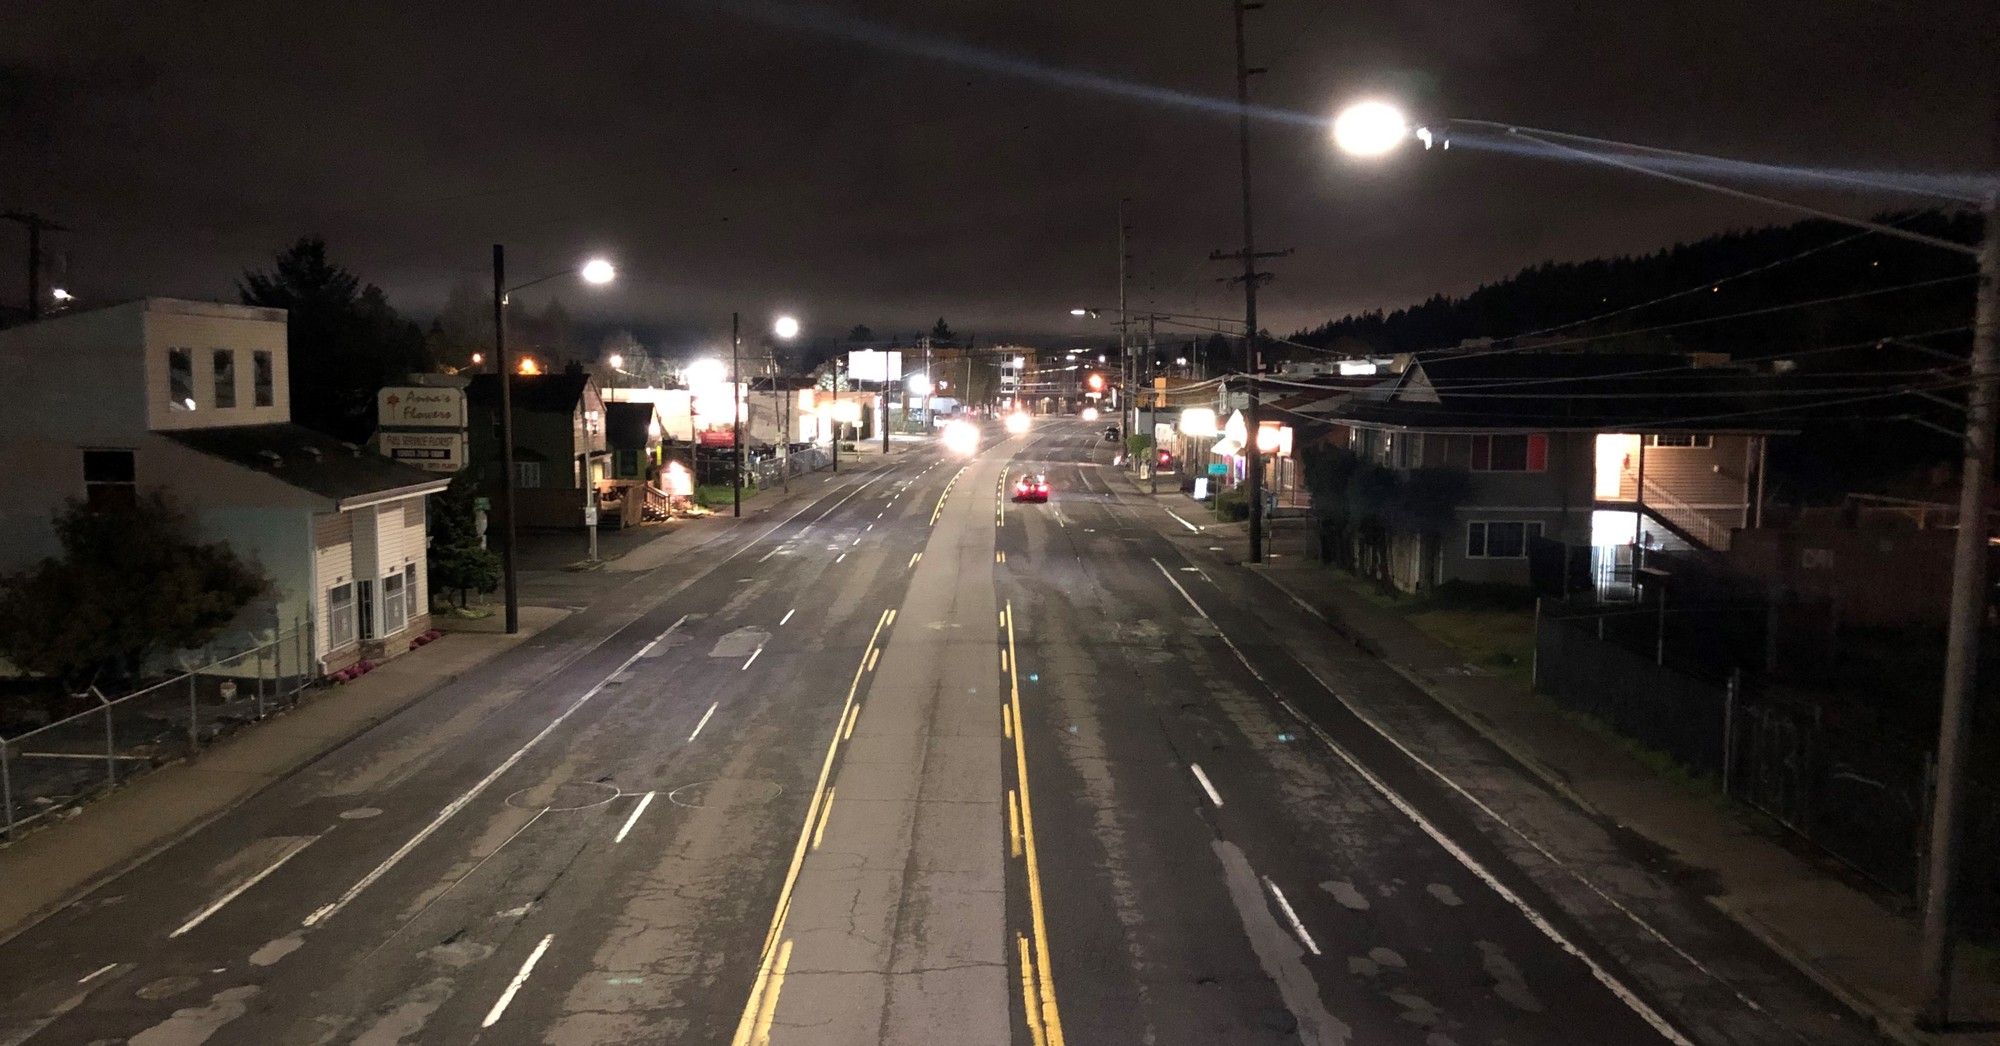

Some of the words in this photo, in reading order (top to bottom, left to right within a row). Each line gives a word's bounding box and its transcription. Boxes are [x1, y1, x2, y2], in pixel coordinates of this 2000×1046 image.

[406, 391, 451, 403] Anna's
[403, 406, 452, 418] Flowers
[386, 435, 401, 445] FULL
[402, 435, 429, 446] SERVICE
[429, 436, 453, 447] FLORIST
